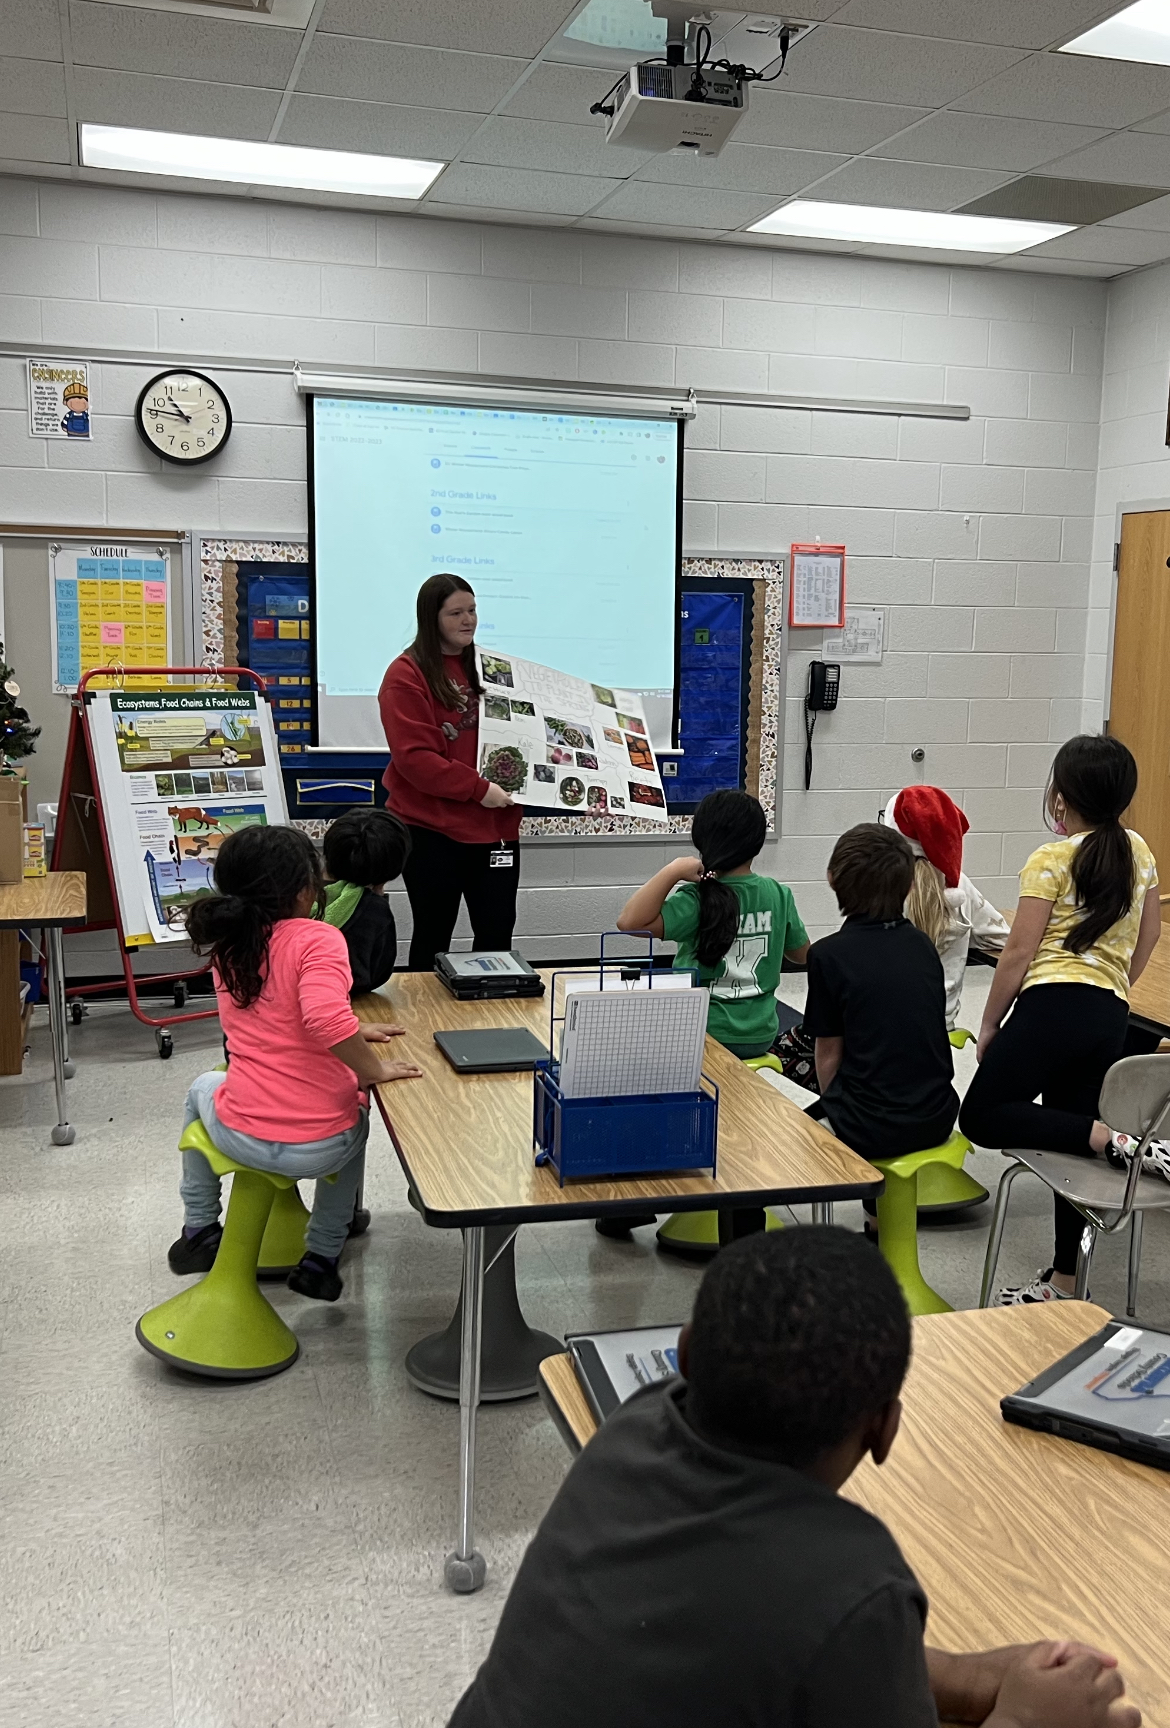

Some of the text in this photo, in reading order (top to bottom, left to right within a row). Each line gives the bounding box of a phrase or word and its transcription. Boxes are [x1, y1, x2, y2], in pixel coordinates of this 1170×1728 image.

[32, 368, 85, 383] ENGINEERS
[164, 386, 173, 396] 11
[177, 381, 189, 392] 12
[198, 387, 202, 397] 1
[153, 397, 166, 408] 10
[206, 400, 215, 410] 2
[149, 409, 159, 419] 9
[211, 414, 220, 423] 3
[155, 423, 164, 433] 8
[207, 427, 215, 437] 4
[167, 435, 175, 445] 7
[196, 437, 206, 447] 5
[180, 441, 190, 451] 6
[430, 489, 497, 501] 2nd Grade Links
[90, 546, 129, 558] SCHEDULE
[431, 555, 495, 565] 3rd Grade Links
[162, 698, 179, 708] Food
[181, 698, 204, 708] Chains
[206, 698, 211, 707] &
[212, 698, 229, 707] Food
[230, 697, 250, 707] Webs
[738, 911, 772, 934] AM
